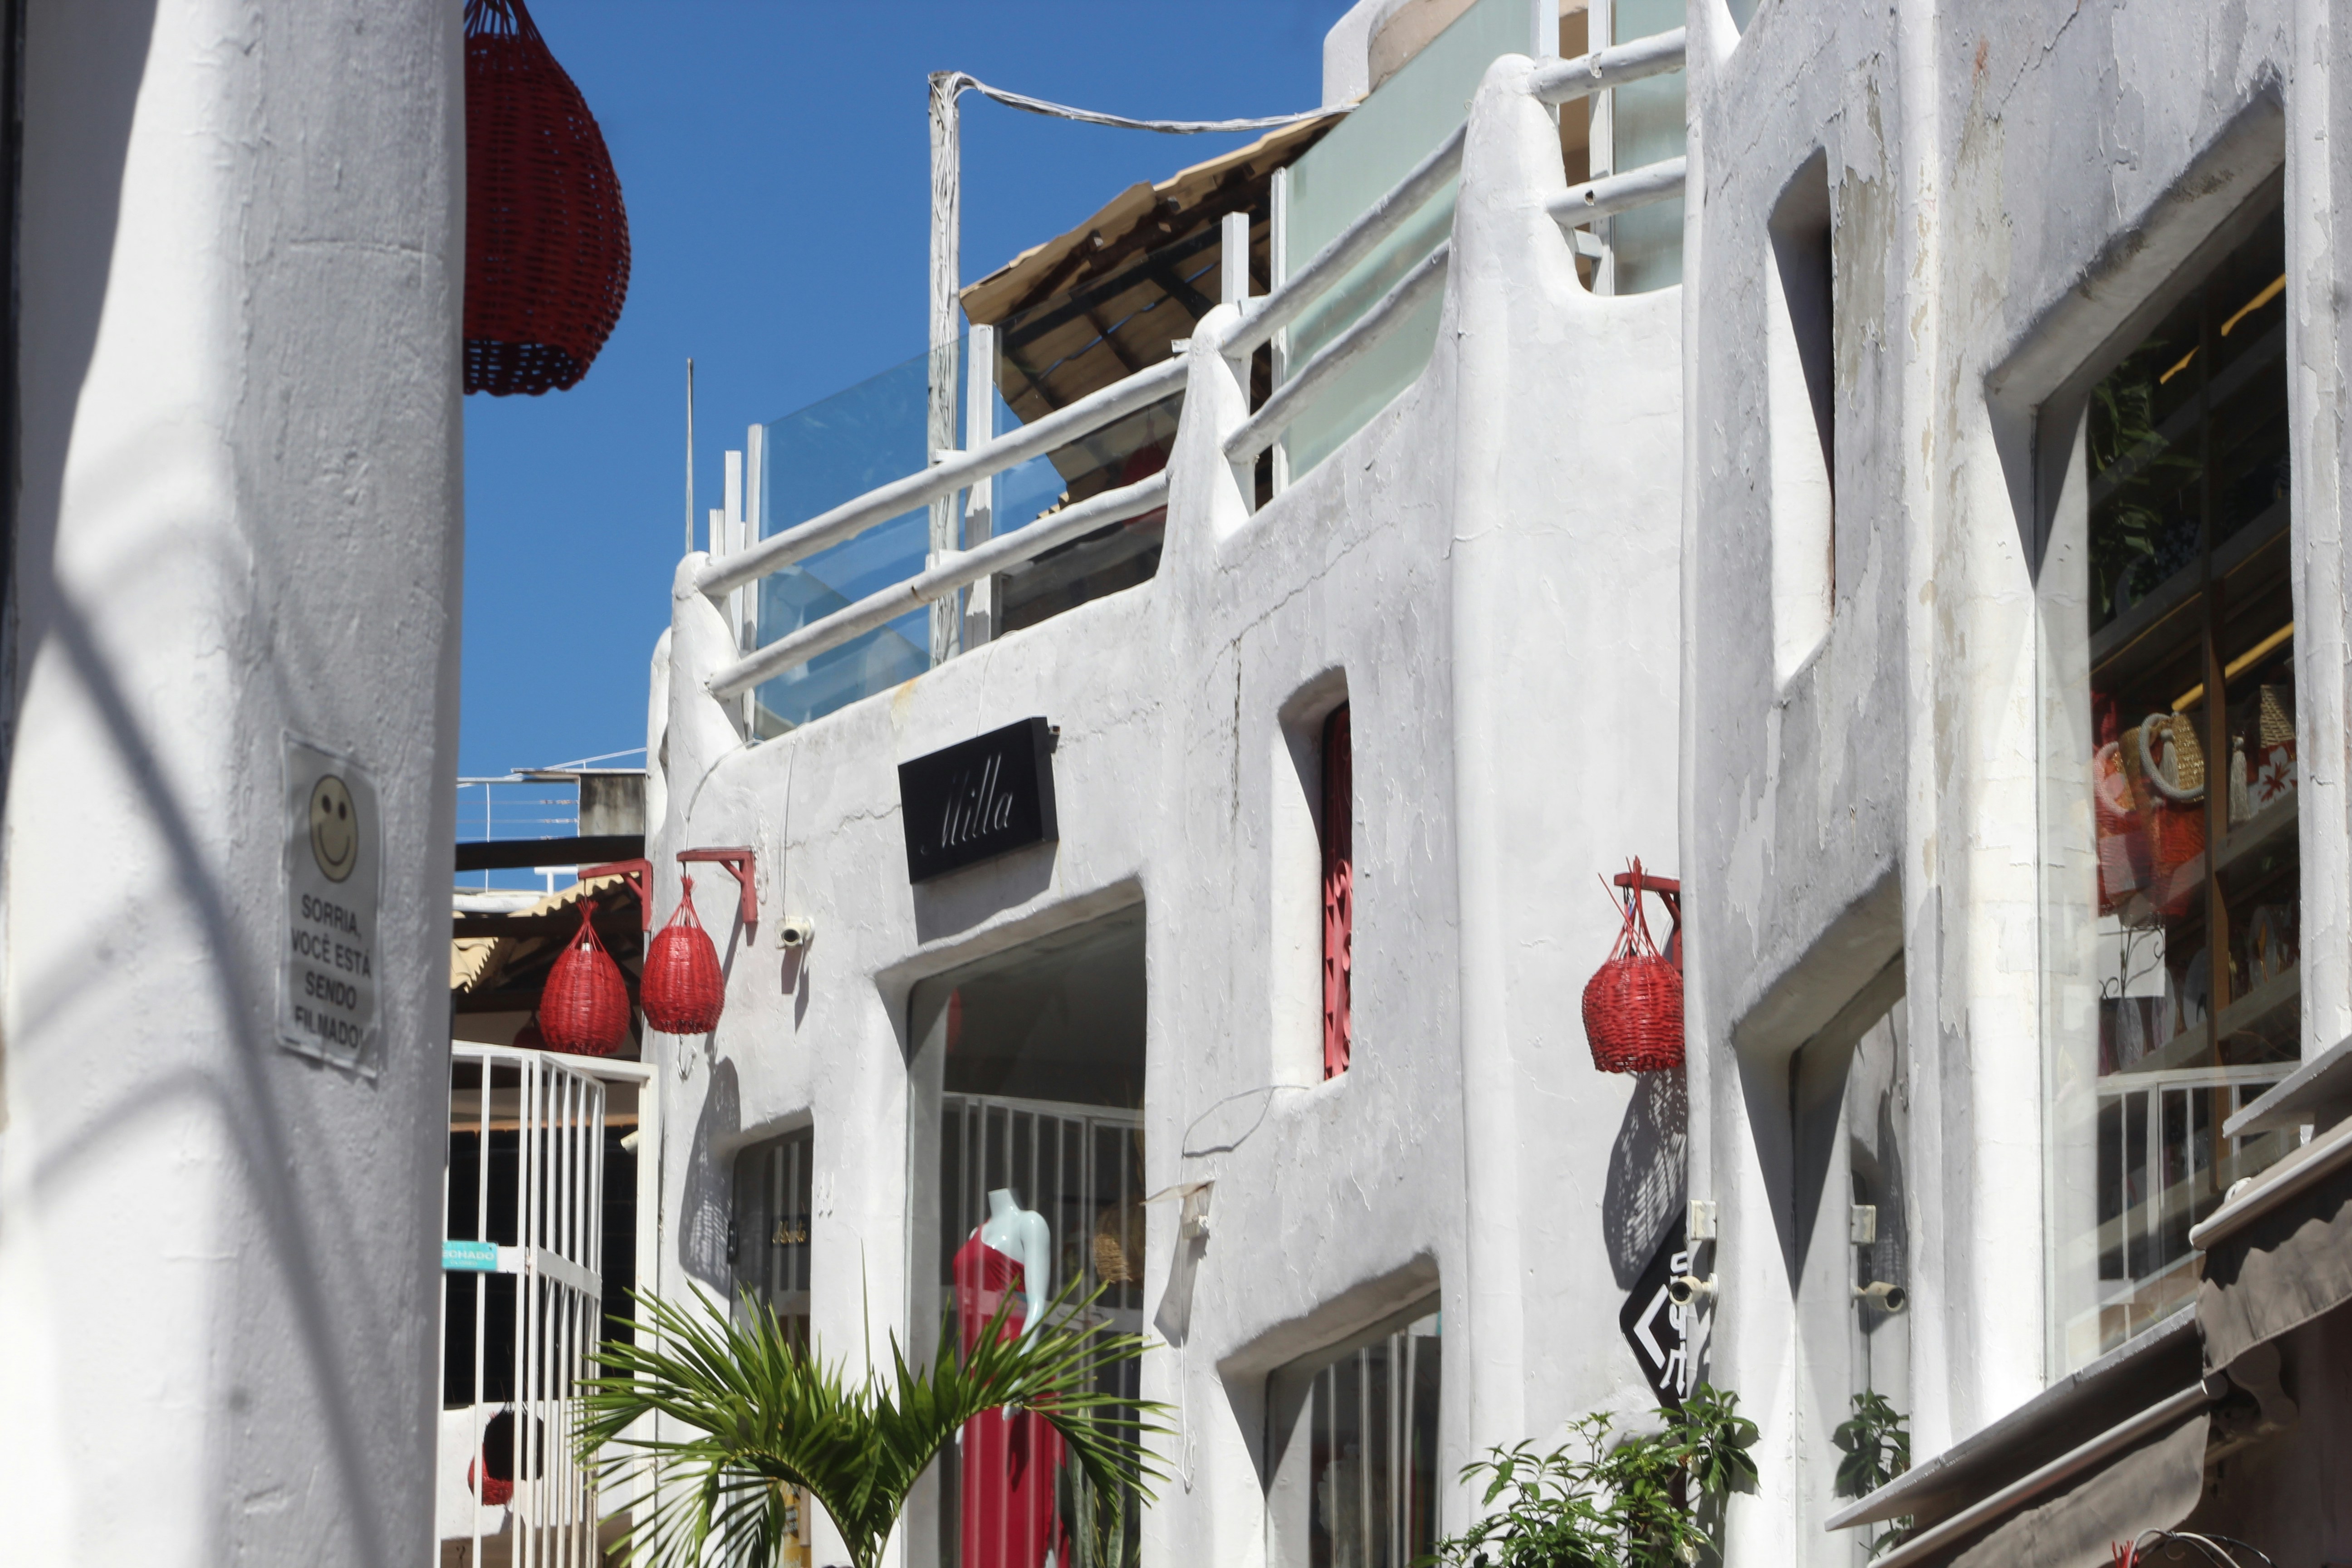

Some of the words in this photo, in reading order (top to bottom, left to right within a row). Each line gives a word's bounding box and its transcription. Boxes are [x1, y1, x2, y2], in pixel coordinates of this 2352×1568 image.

[301, 893, 362, 941] SORRIA,
[292, 927, 331, 963] VOCÊ
[335, 942, 371, 978] ESTÁ
[306, 970, 357, 1010] SENDO
